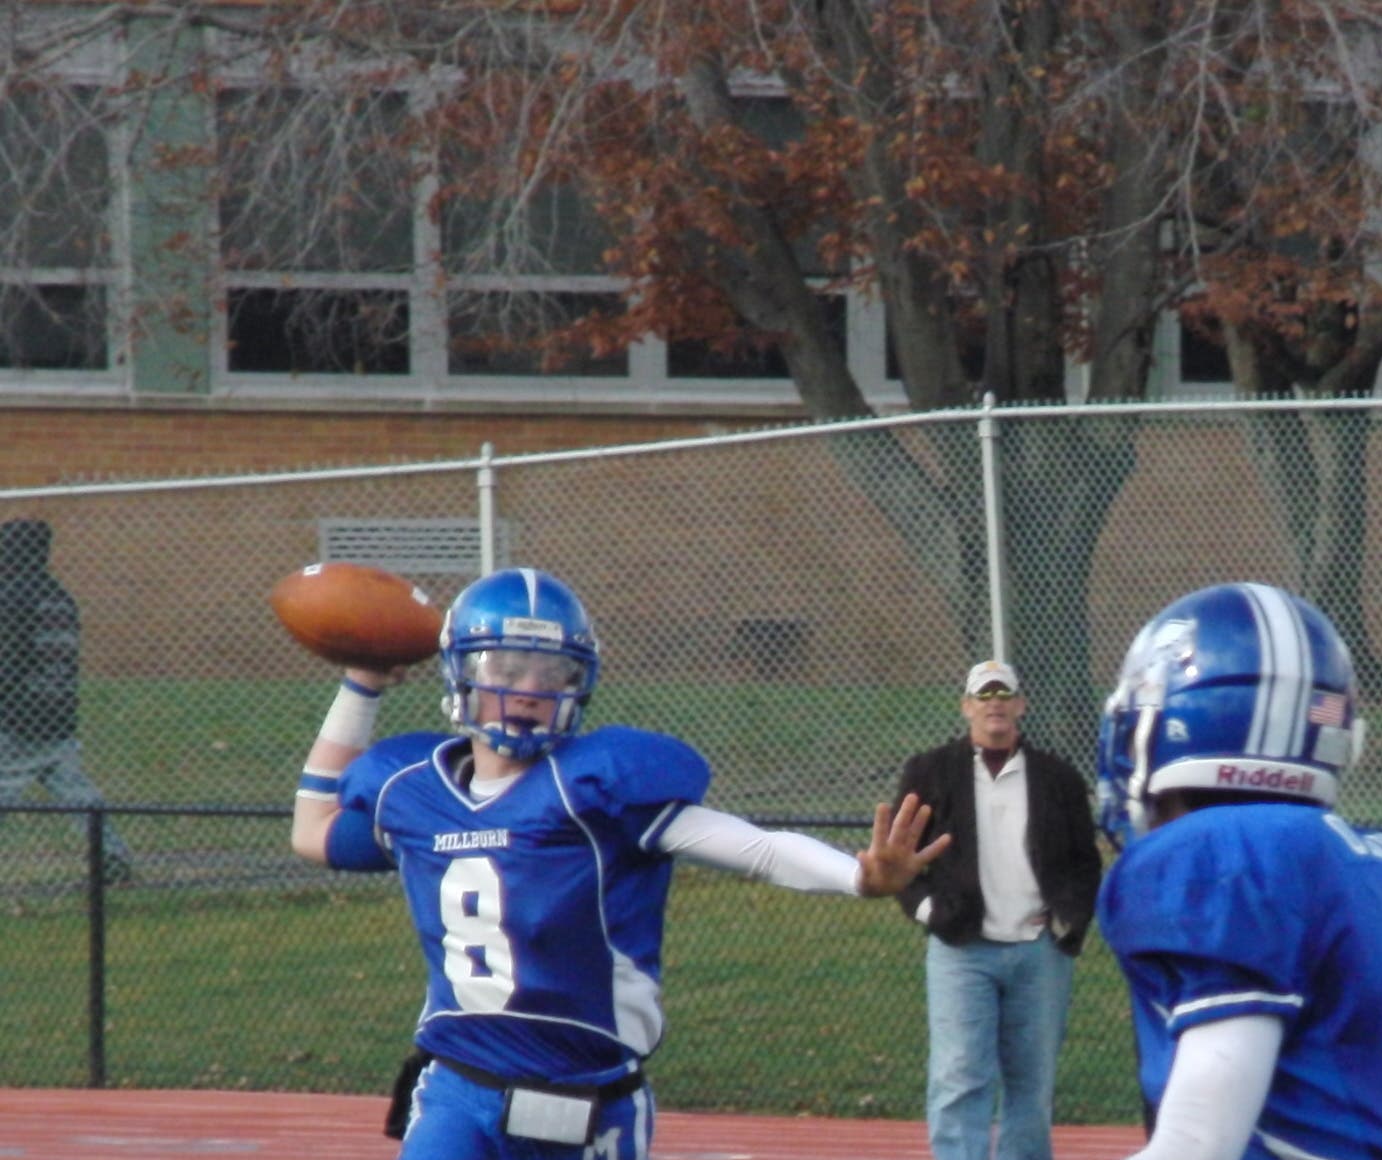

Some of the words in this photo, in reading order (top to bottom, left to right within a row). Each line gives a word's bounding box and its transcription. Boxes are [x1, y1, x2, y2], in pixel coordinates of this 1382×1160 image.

[1217, 764, 1316, 793] Riddell
[433, 828, 509, 853] MILLBURN
[440, 856, 516, 1012] 8
